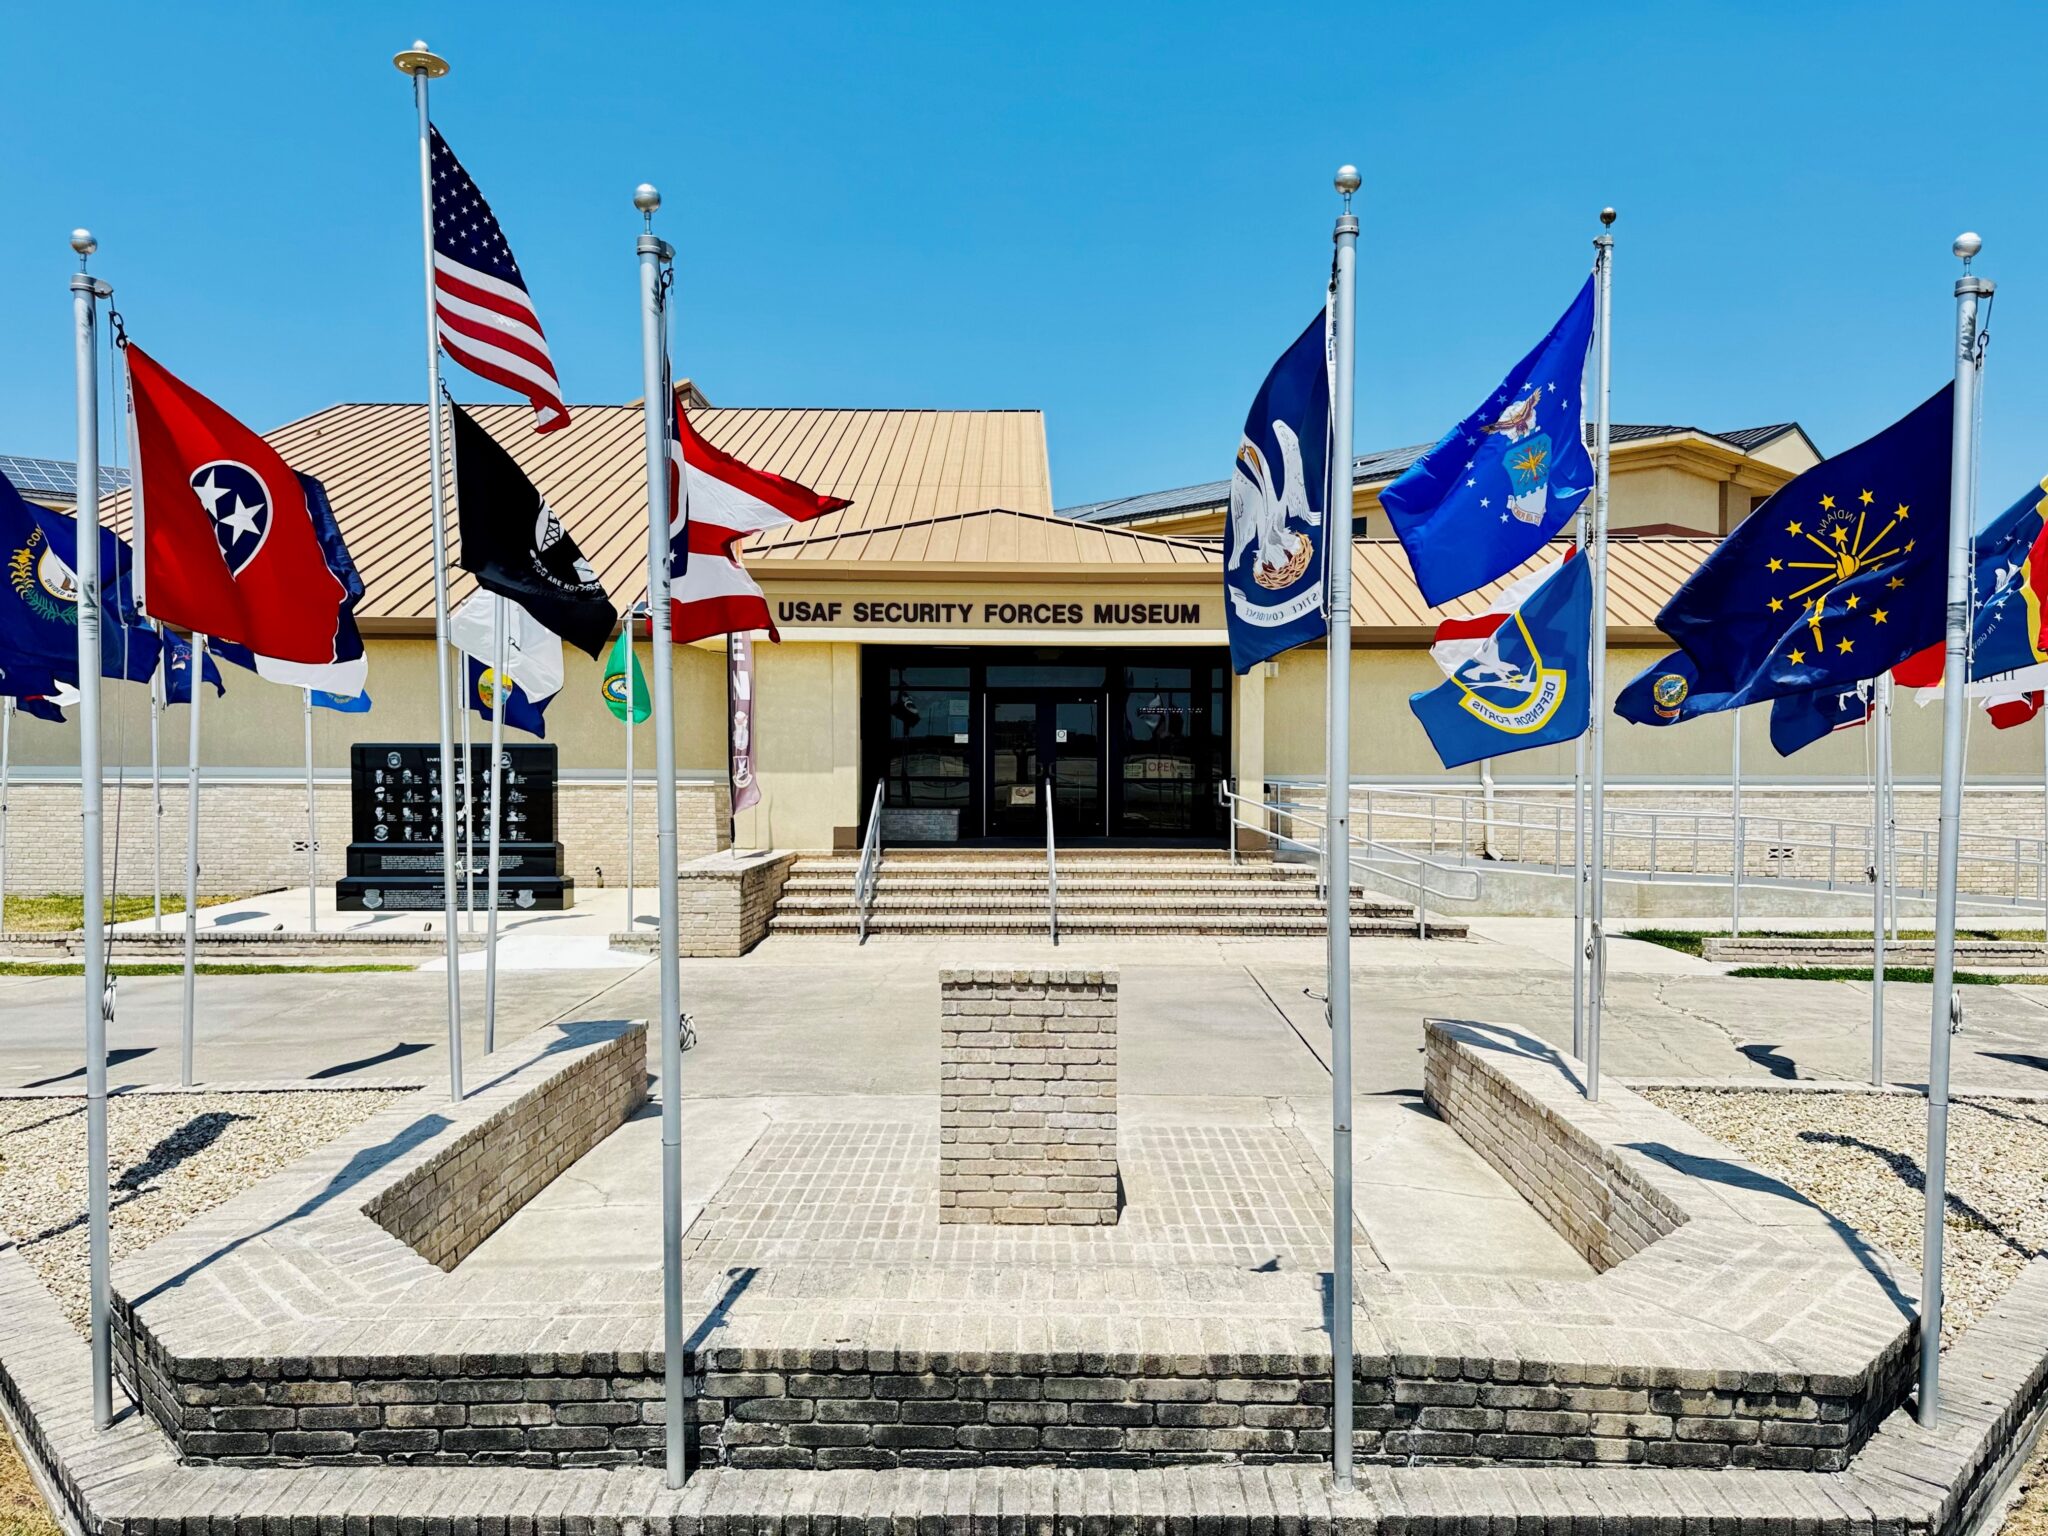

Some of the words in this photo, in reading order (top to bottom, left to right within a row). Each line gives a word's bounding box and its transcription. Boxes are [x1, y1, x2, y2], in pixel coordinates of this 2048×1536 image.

[44, 578, 66, 596] DIVIDED
[547, 575, 562, 587] ARE
[563, 583, 580, 592] NOT
[778, 602, 842, 623] USAF
[852, 602, 972, 624] SECURITY
[983, 602, 1083, 624] FORCES
[1093, 602, 1200, 624] MUSEUM
[1147, 761, 1177, 772] OPEN
